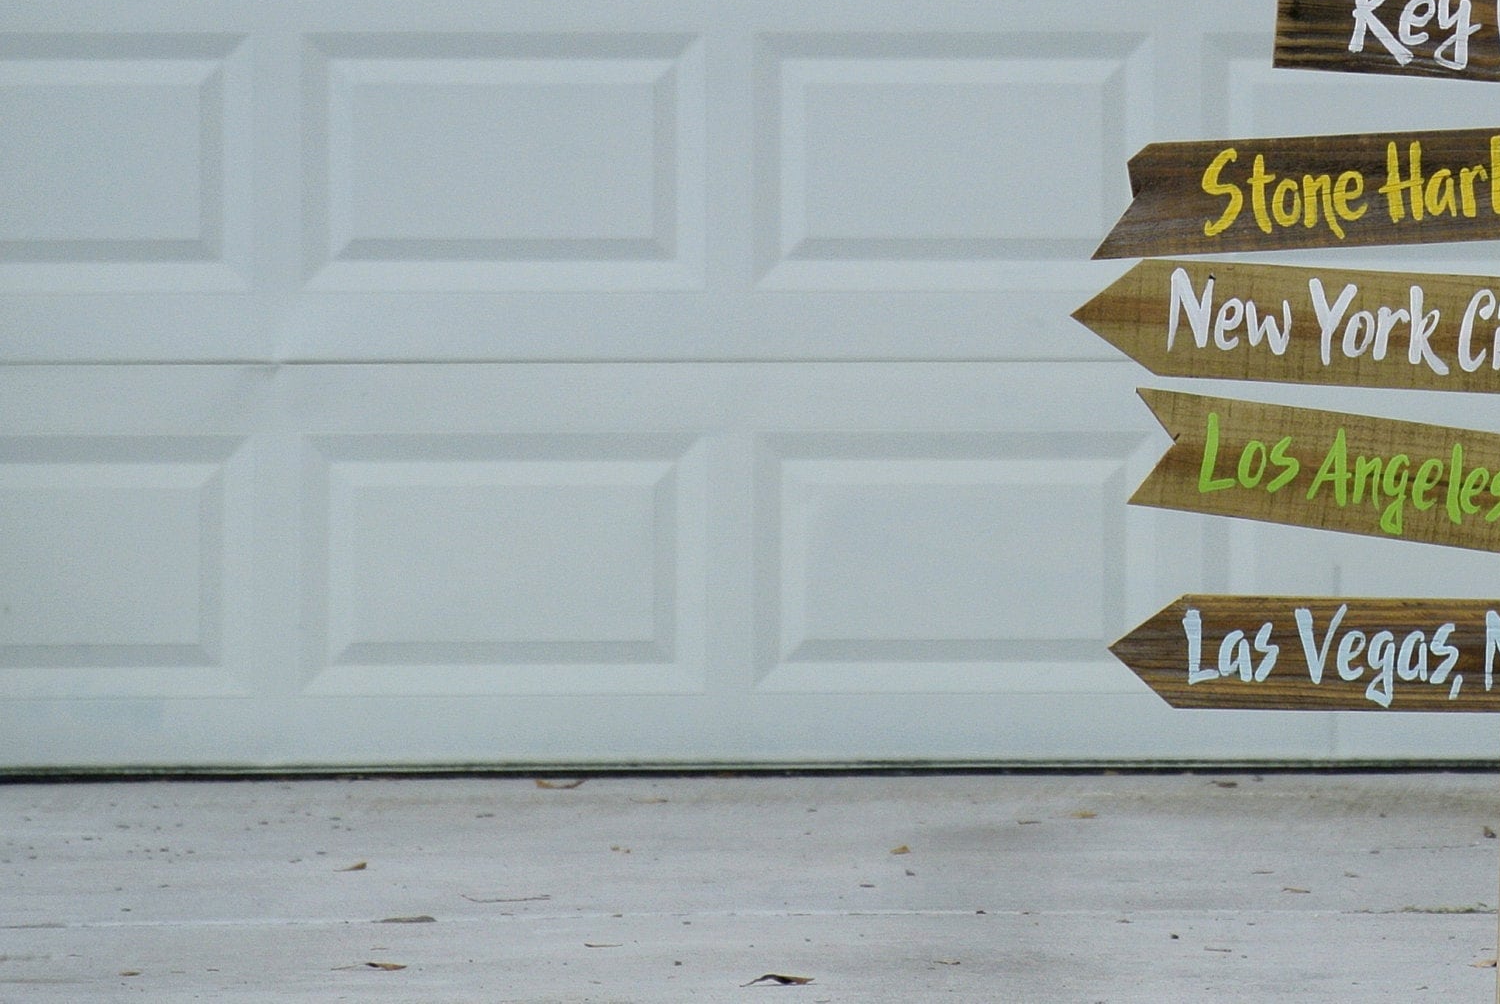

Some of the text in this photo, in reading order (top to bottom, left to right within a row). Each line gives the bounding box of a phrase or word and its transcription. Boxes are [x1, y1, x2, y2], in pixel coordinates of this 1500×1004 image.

[1202, 148, 1367, 238] Stone
[1166, 267, 1291, 356] New
[1308, 277, 1449, 376] York
[1198, 412, 1298, 494] Los
[1181, 608, 1278, 684] Las
